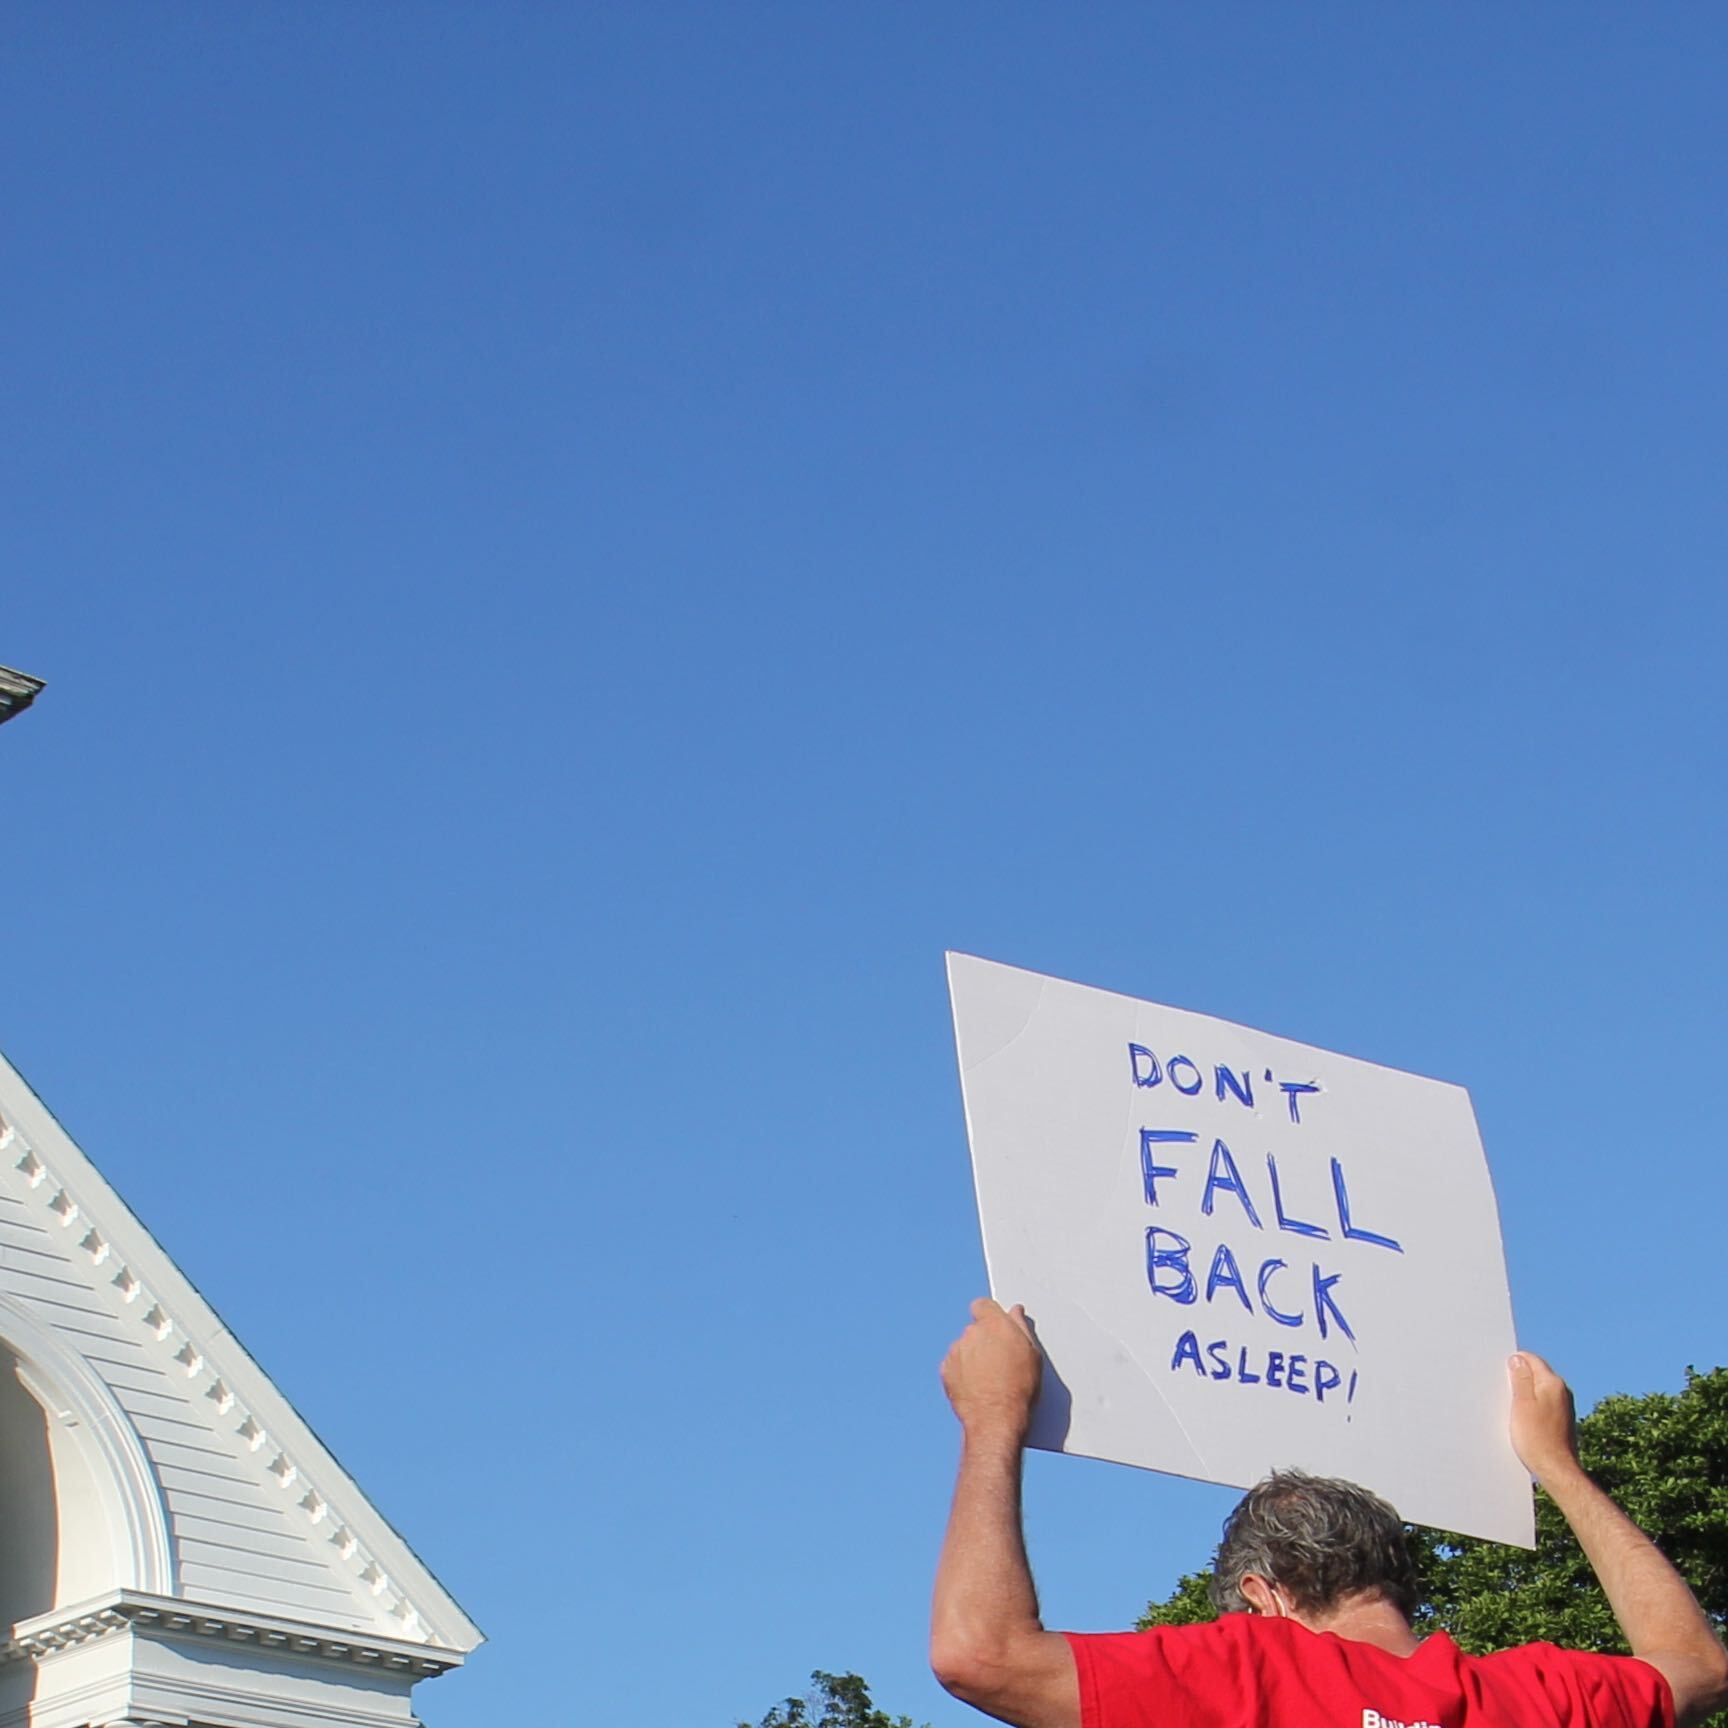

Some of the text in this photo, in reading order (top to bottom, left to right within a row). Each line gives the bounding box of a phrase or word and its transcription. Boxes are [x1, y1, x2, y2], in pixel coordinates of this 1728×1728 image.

[1128, 1042, 1321, 1124] DON'T
[1139, 1125, 1404, 1254] FALL
[1145, 1225, 1359, 1353] BACK
[1171, 1329, 1359, 1423] ASLEEP!
